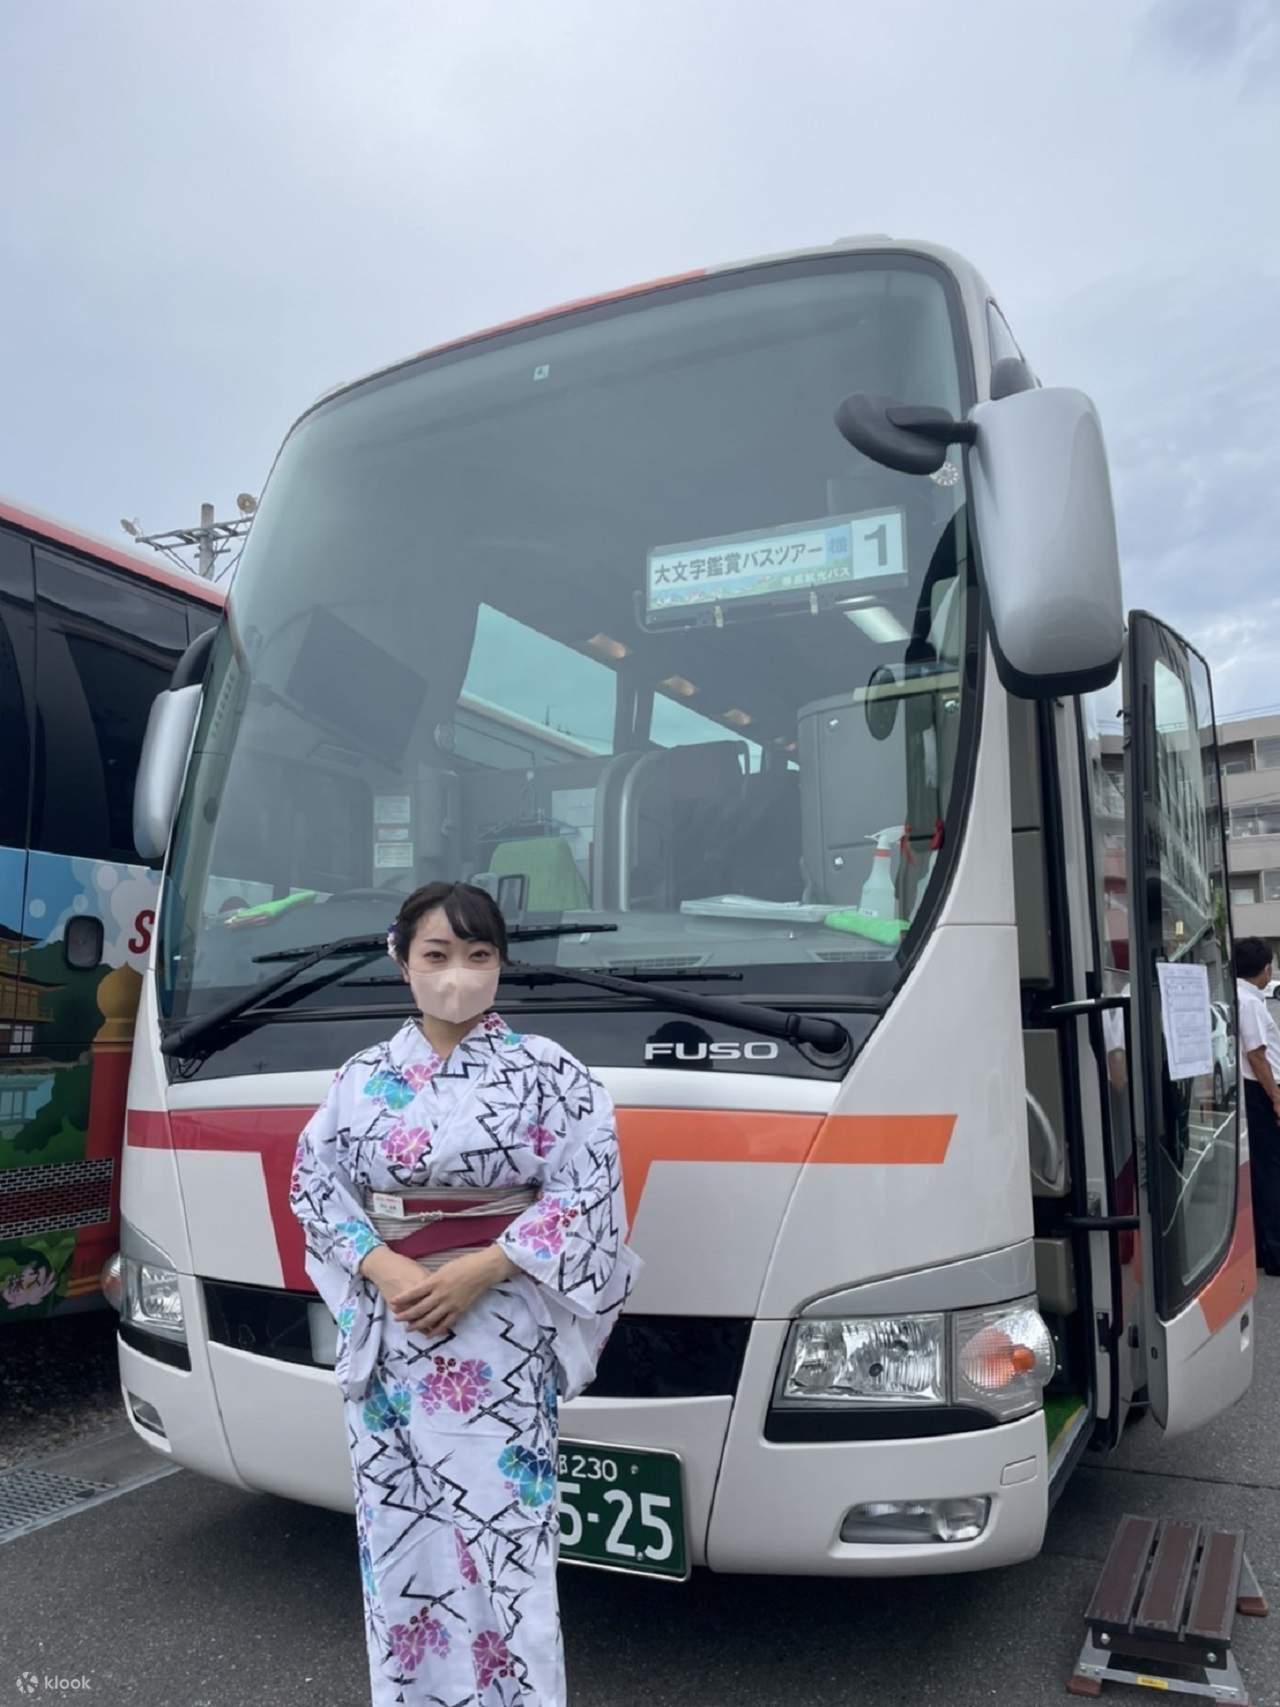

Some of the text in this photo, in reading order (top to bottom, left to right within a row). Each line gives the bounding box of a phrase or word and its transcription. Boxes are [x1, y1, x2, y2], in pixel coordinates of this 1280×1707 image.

[654, 543, 823, 585] 大文字鑑賞バスツアー
[863, 523, 888, 567] 1
[644, 1041, 778, 1060] FUSO
